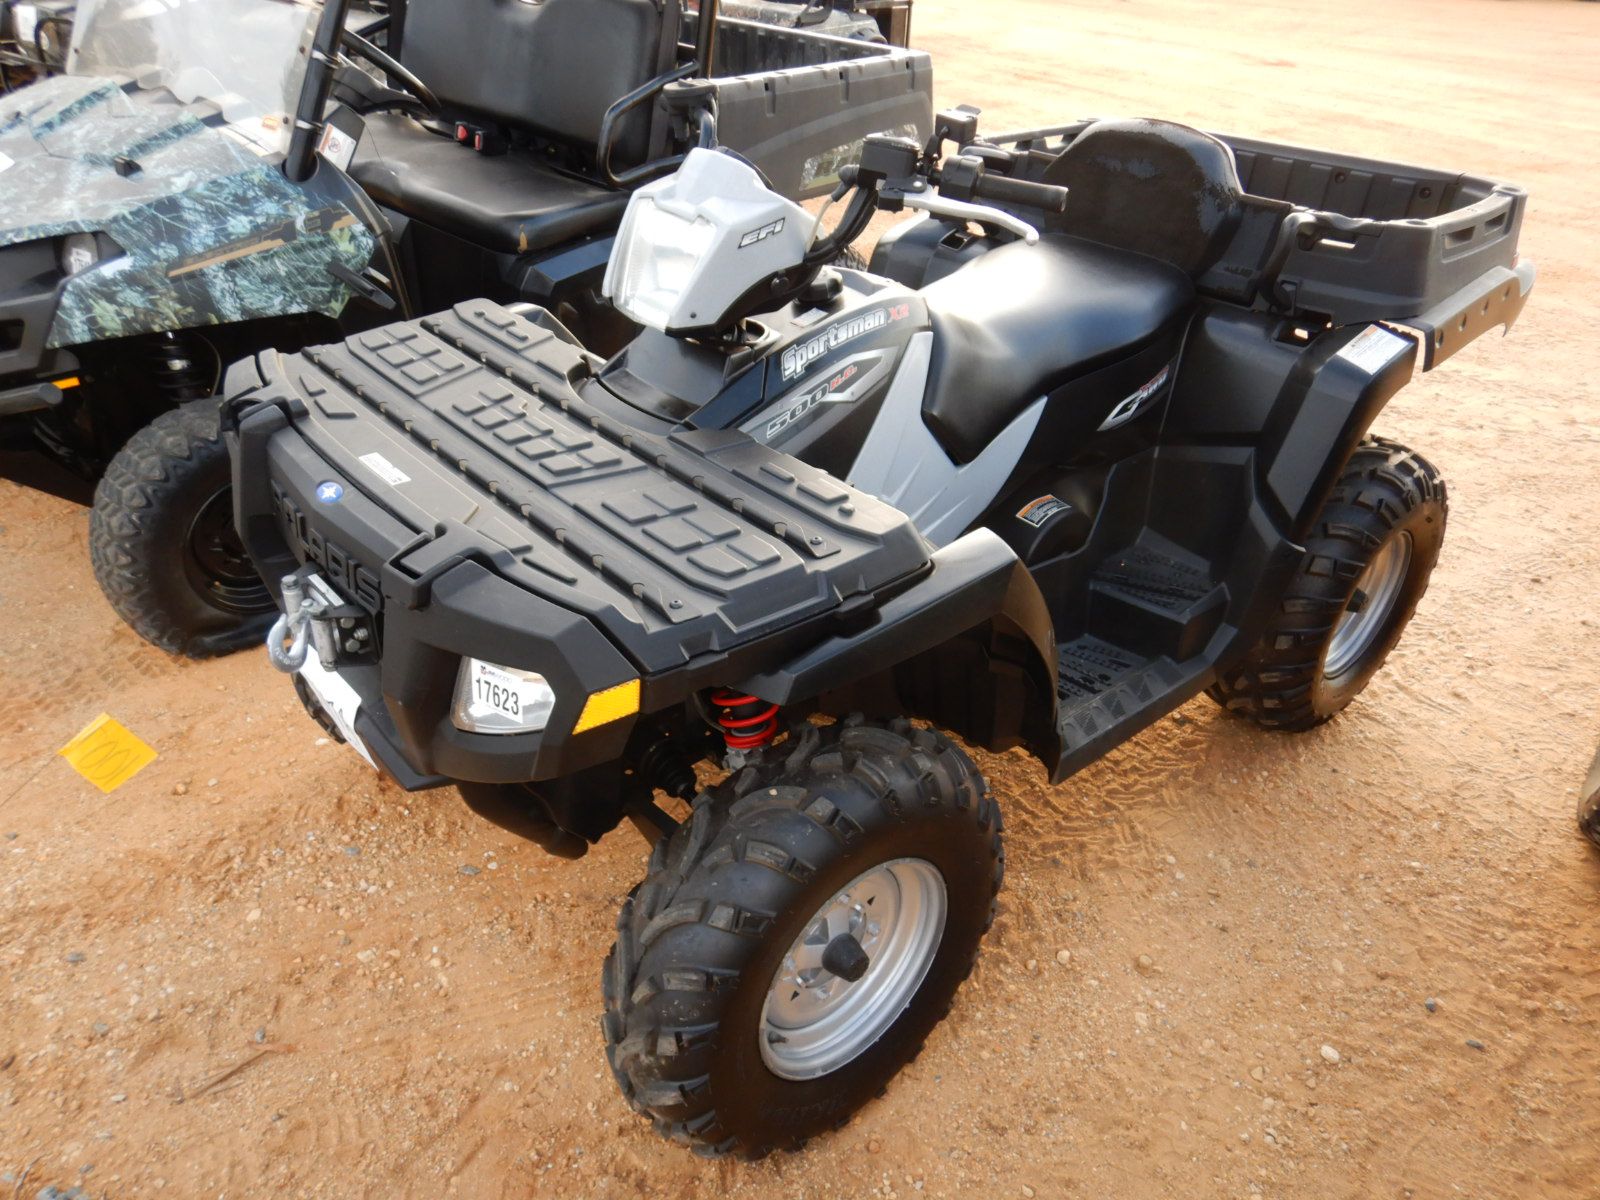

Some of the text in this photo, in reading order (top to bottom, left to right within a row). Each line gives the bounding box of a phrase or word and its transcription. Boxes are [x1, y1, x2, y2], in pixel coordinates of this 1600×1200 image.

[738, 217, 786, 249] EFI
[781, 308, 888, 381] Sportsman
[766, 383, 829, 438] 500
[475, 677, 519, 715] 17623
